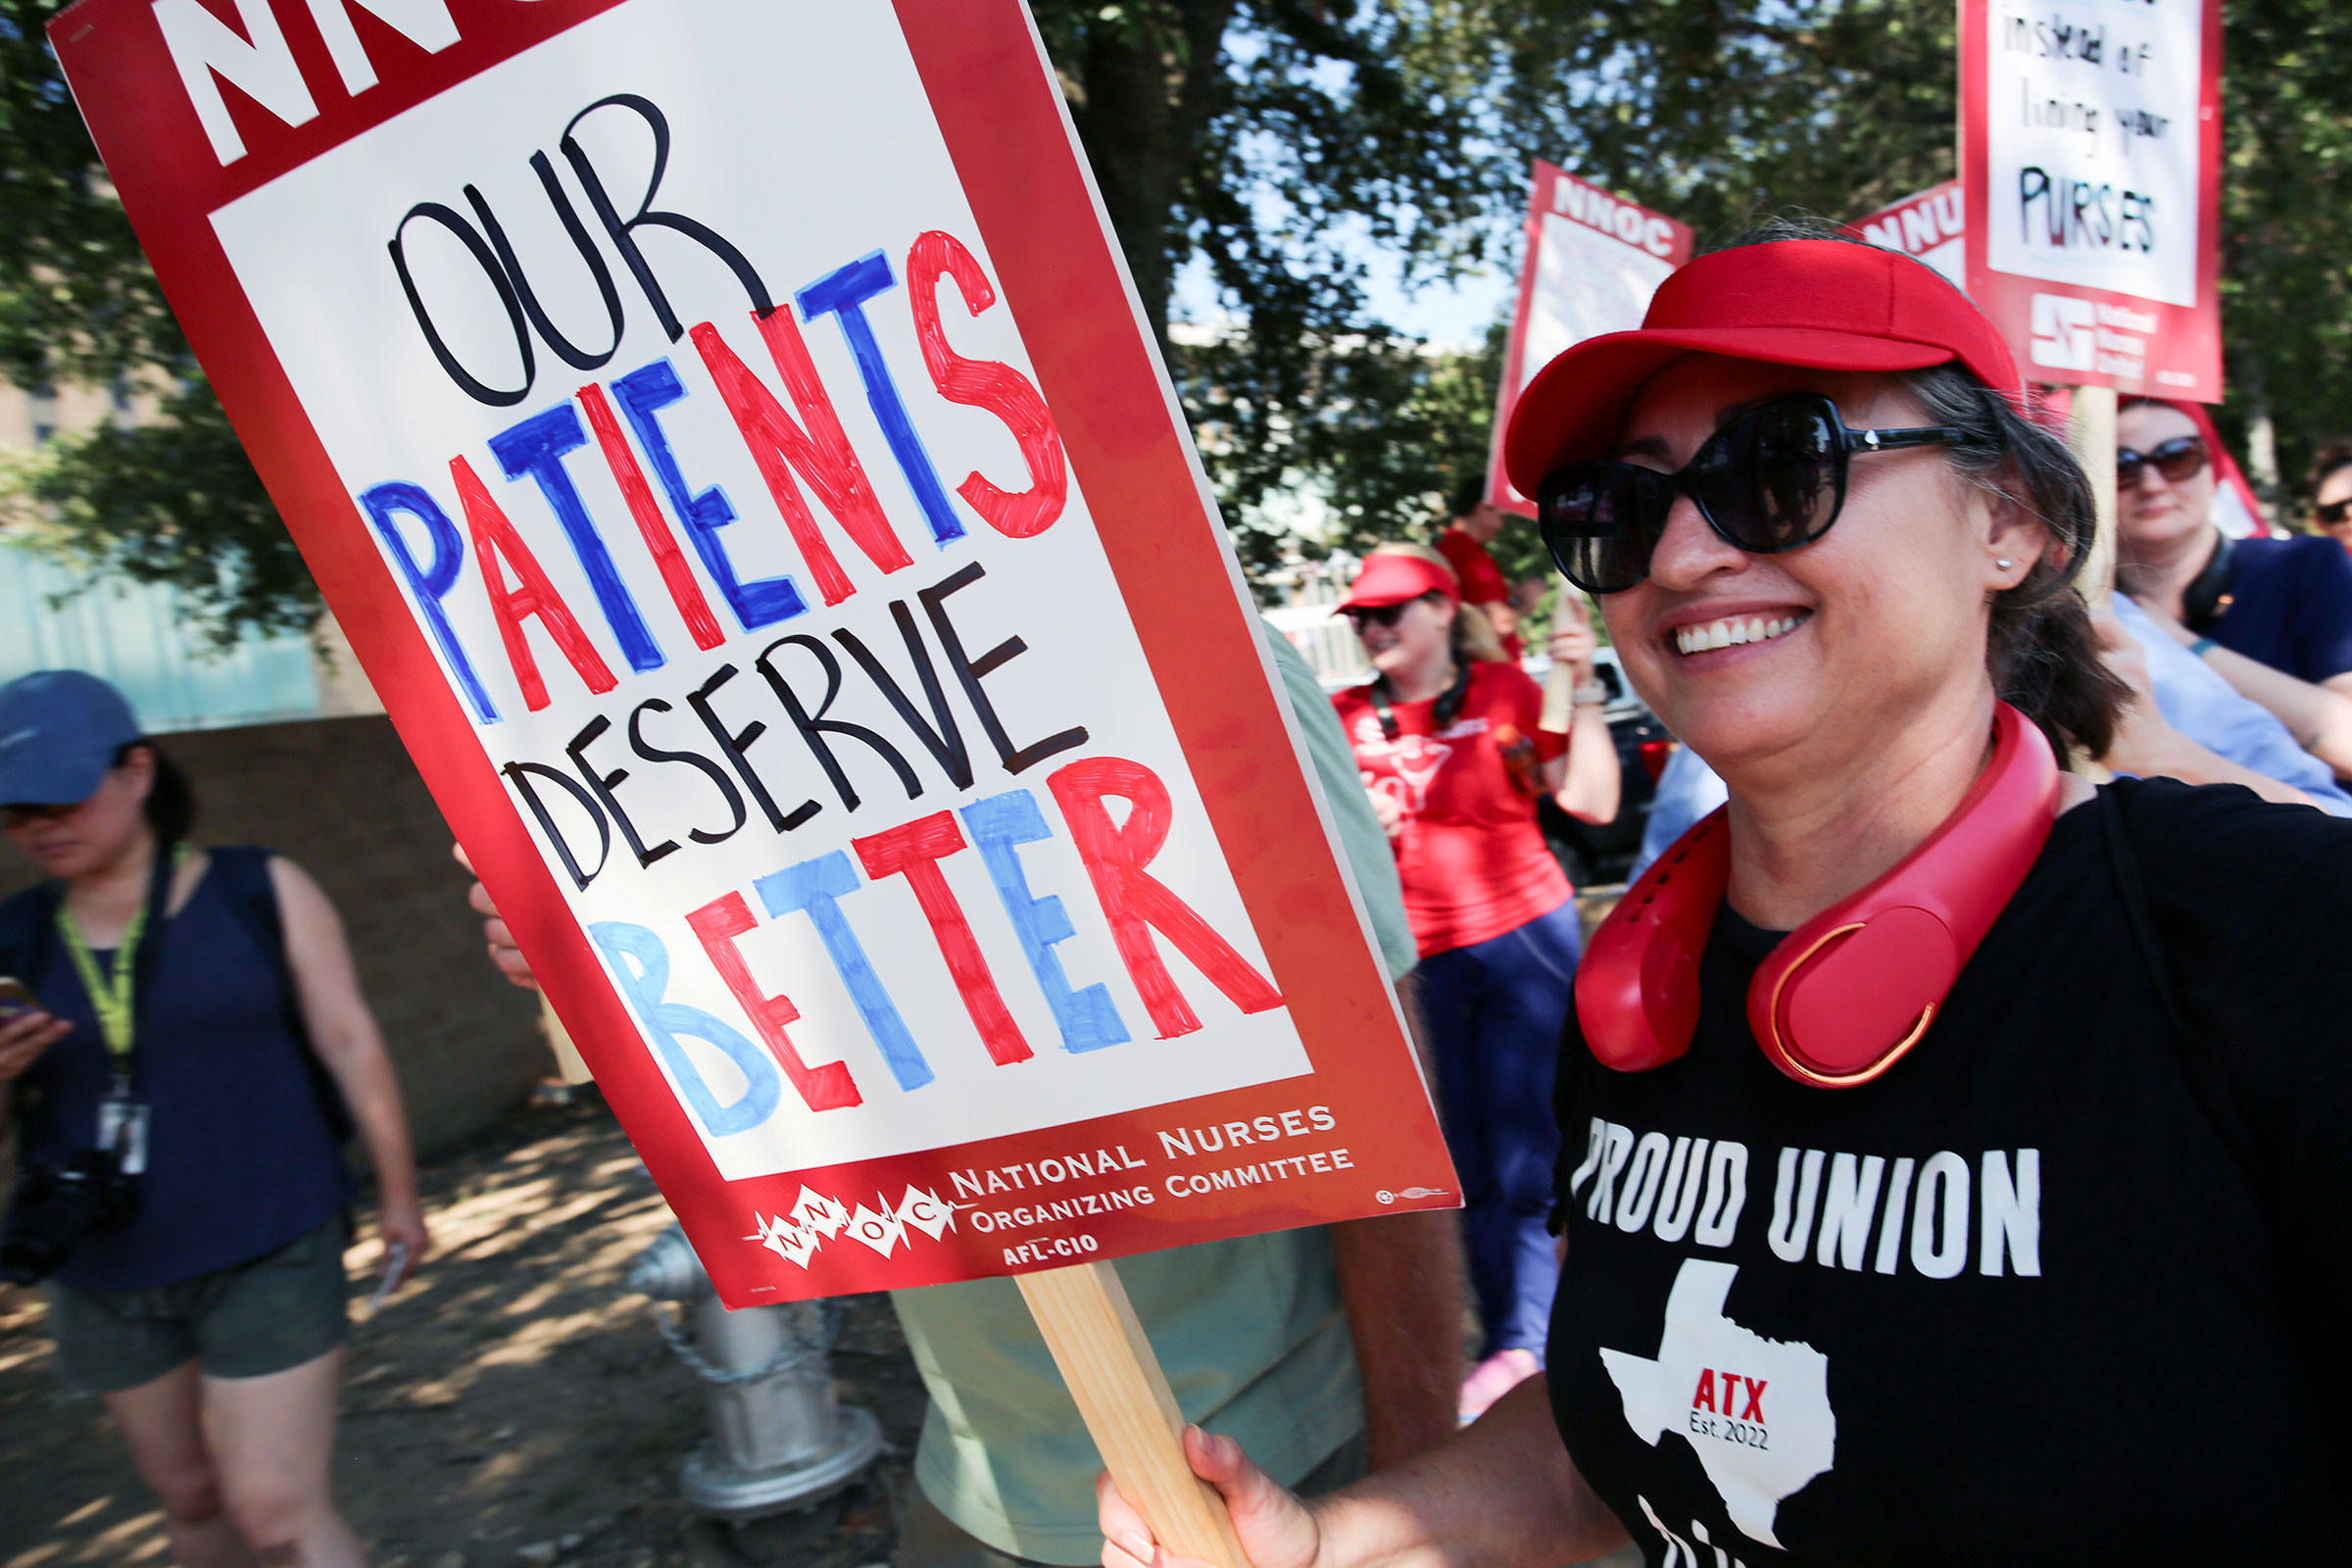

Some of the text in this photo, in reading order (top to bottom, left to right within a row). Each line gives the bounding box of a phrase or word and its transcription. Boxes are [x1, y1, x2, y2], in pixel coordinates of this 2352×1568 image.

[388, 93, 775, 408] OUR
[1553, 174, 1675, 257] NNOC
[2020, 166, 2156, 253] PURSES
[357, 230, 1068, 725] PATIENTS
[500, 561, 1090, 892] DESERVE
[587, 756, 1287, 1139] BETTER
[948, 1104, 1338, 1200] NATIONAL NURSES
[970, 1148, 1355, 1234] ORGANIZING COMMITTEE
[1570, 1116, 2042, 1280] PROUD UNION
[1002, 1234, 1100, 1266] AFL-CIO
[1689, 1410, 1770, 1451] Est. 2022
[1692, 1367, 1769, 1425] ATX
